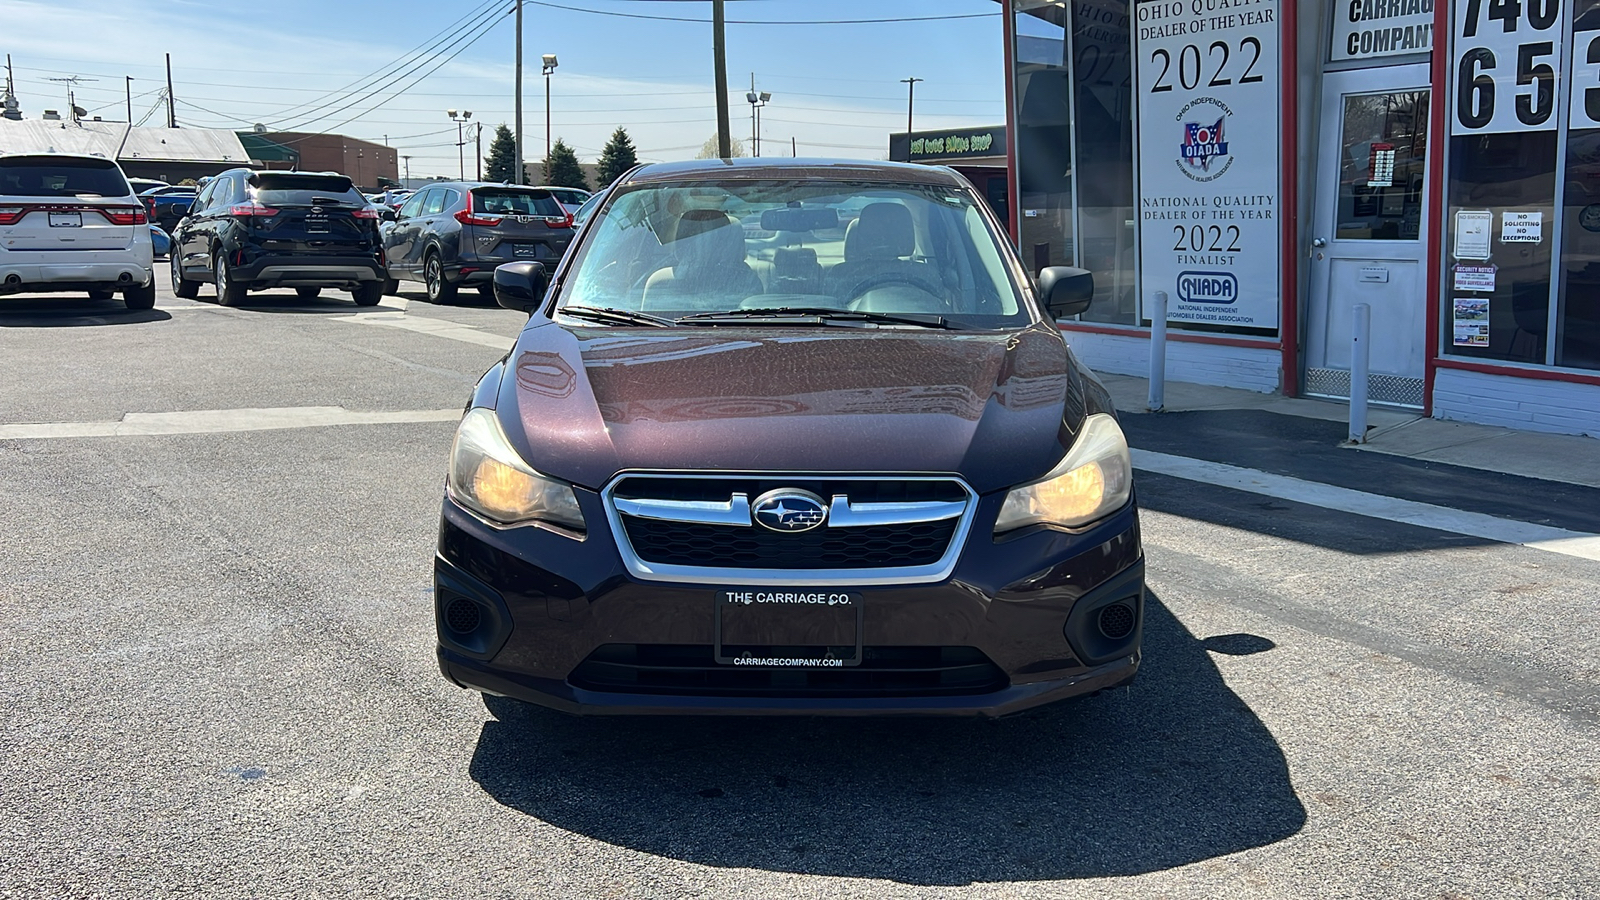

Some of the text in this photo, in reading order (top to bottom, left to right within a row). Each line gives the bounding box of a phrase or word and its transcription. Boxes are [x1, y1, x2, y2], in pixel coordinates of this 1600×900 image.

[1138, 2, 1183, 21] OHIO
[1140, 22, 1187, 40] DEALER
[1189, 19, 1207, 33] OF
[1209, 15, 1236, 31] THE
[1238, 9, 1274, 27] YEAR
[1150, 36, 1264, 93] 2022
[1175, 97, 1234, 121] OHIO INDEPENDENT
[971, 133, 992, 152] SHOP
[1186, 144, 1220, 156] OIADA
[1143, 195, 1275, 208] NATIONAL QUALITY
[1144, 209, 1273, 220] DEALER OF THE YEAR
[1173, 225, 1242, 252] 2022
[1177, 255, 1235, 265] FINALIST
[1181, 278, 1232, 297] NIADA
[726, 592, 852, 605] THE CARRIAGE CO.
[733, 657, 843, 667] CARRIAGECOMPANY.COM
